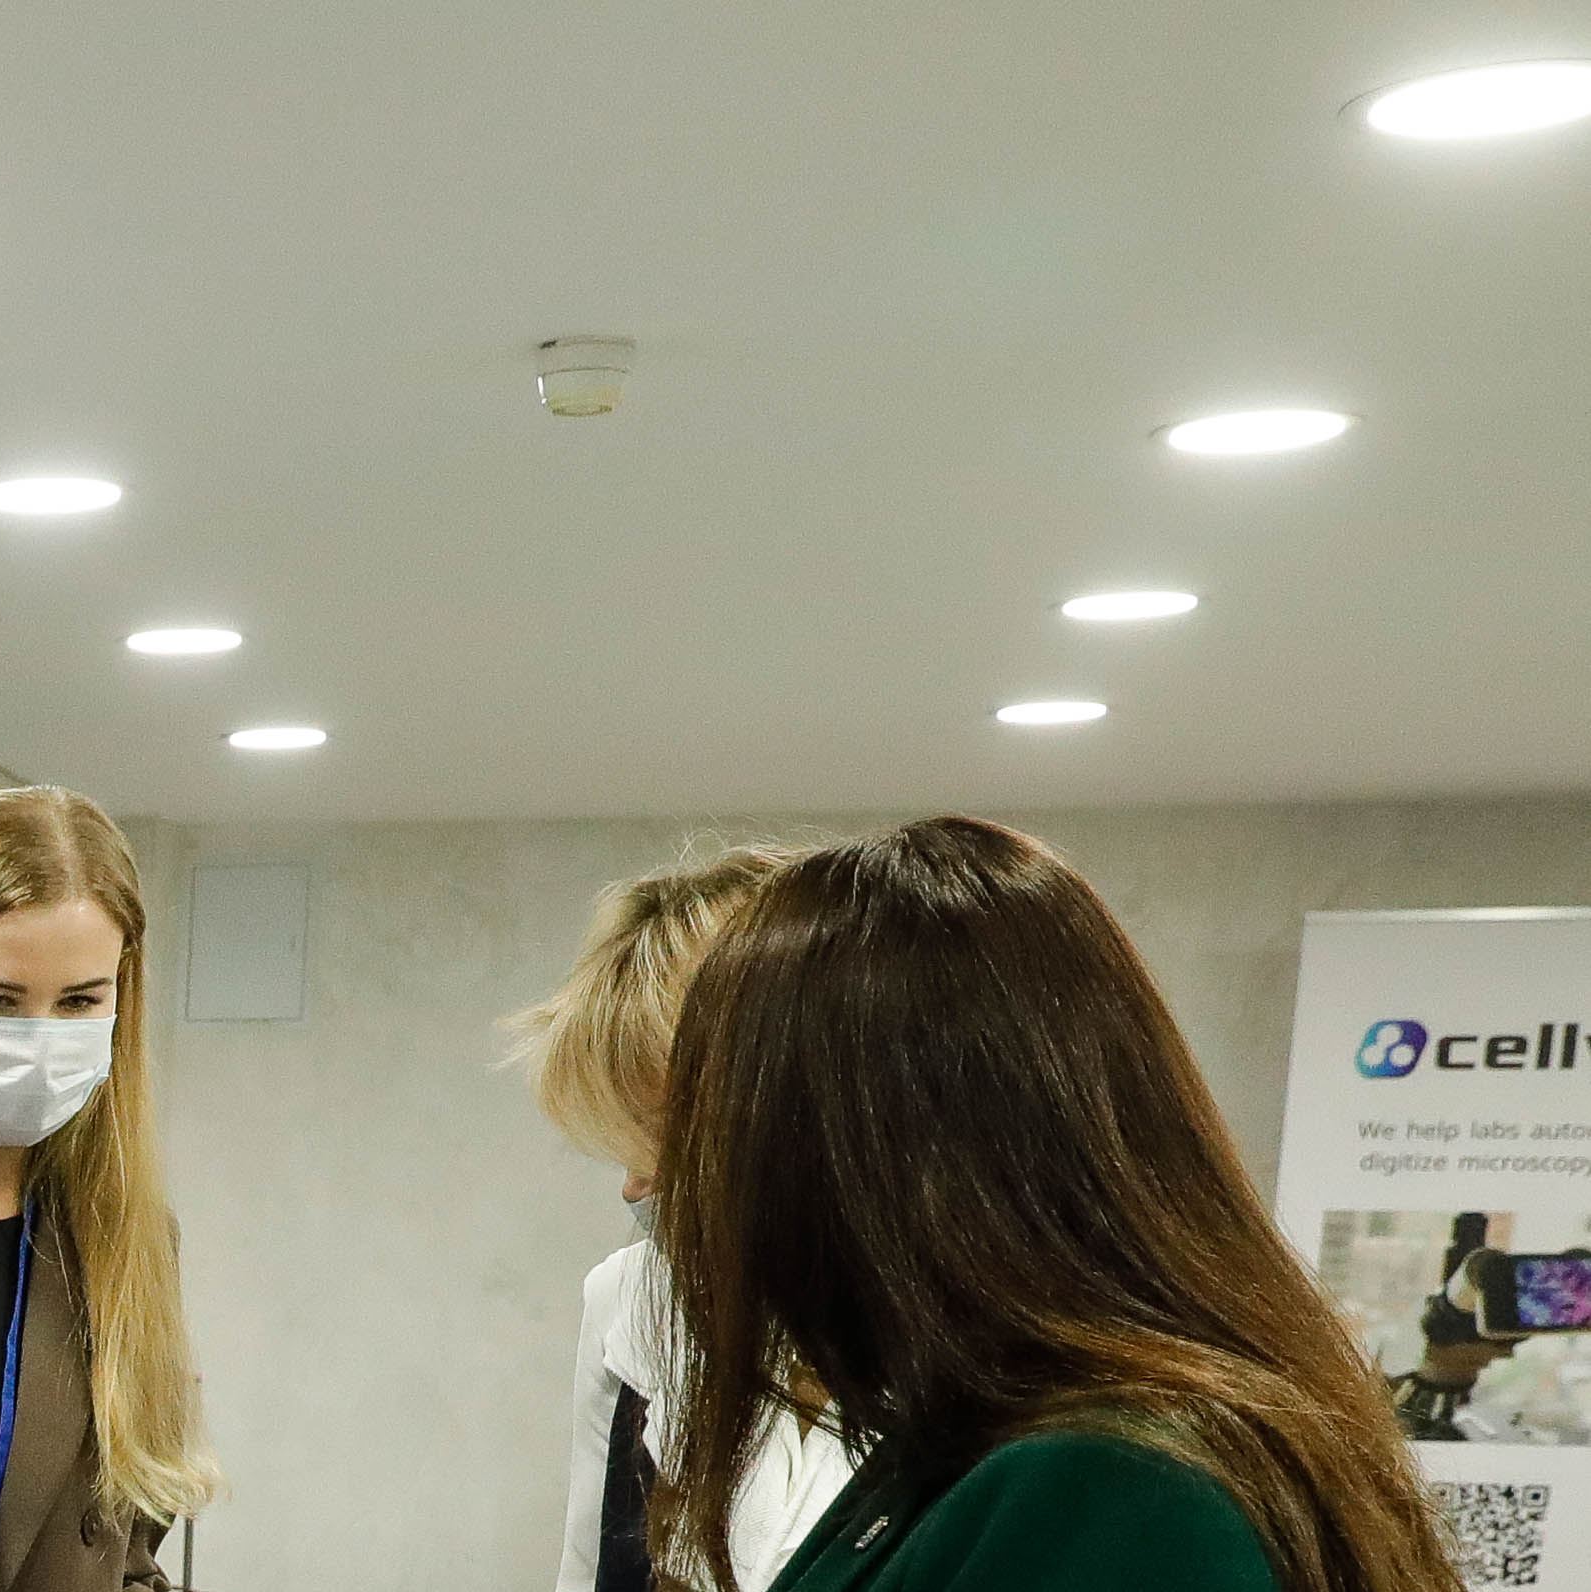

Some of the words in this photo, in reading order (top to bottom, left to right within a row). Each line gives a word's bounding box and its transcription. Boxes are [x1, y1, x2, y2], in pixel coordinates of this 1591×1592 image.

[1435, 1023, 1591, 1069] cell
[1358, 1121, 1396, 1139] We
[1407, 1119, 1460, 1141] help
[1470, 1120, 1520, 1139] labs
[1359, 1154, 1449, 1176] digitize
